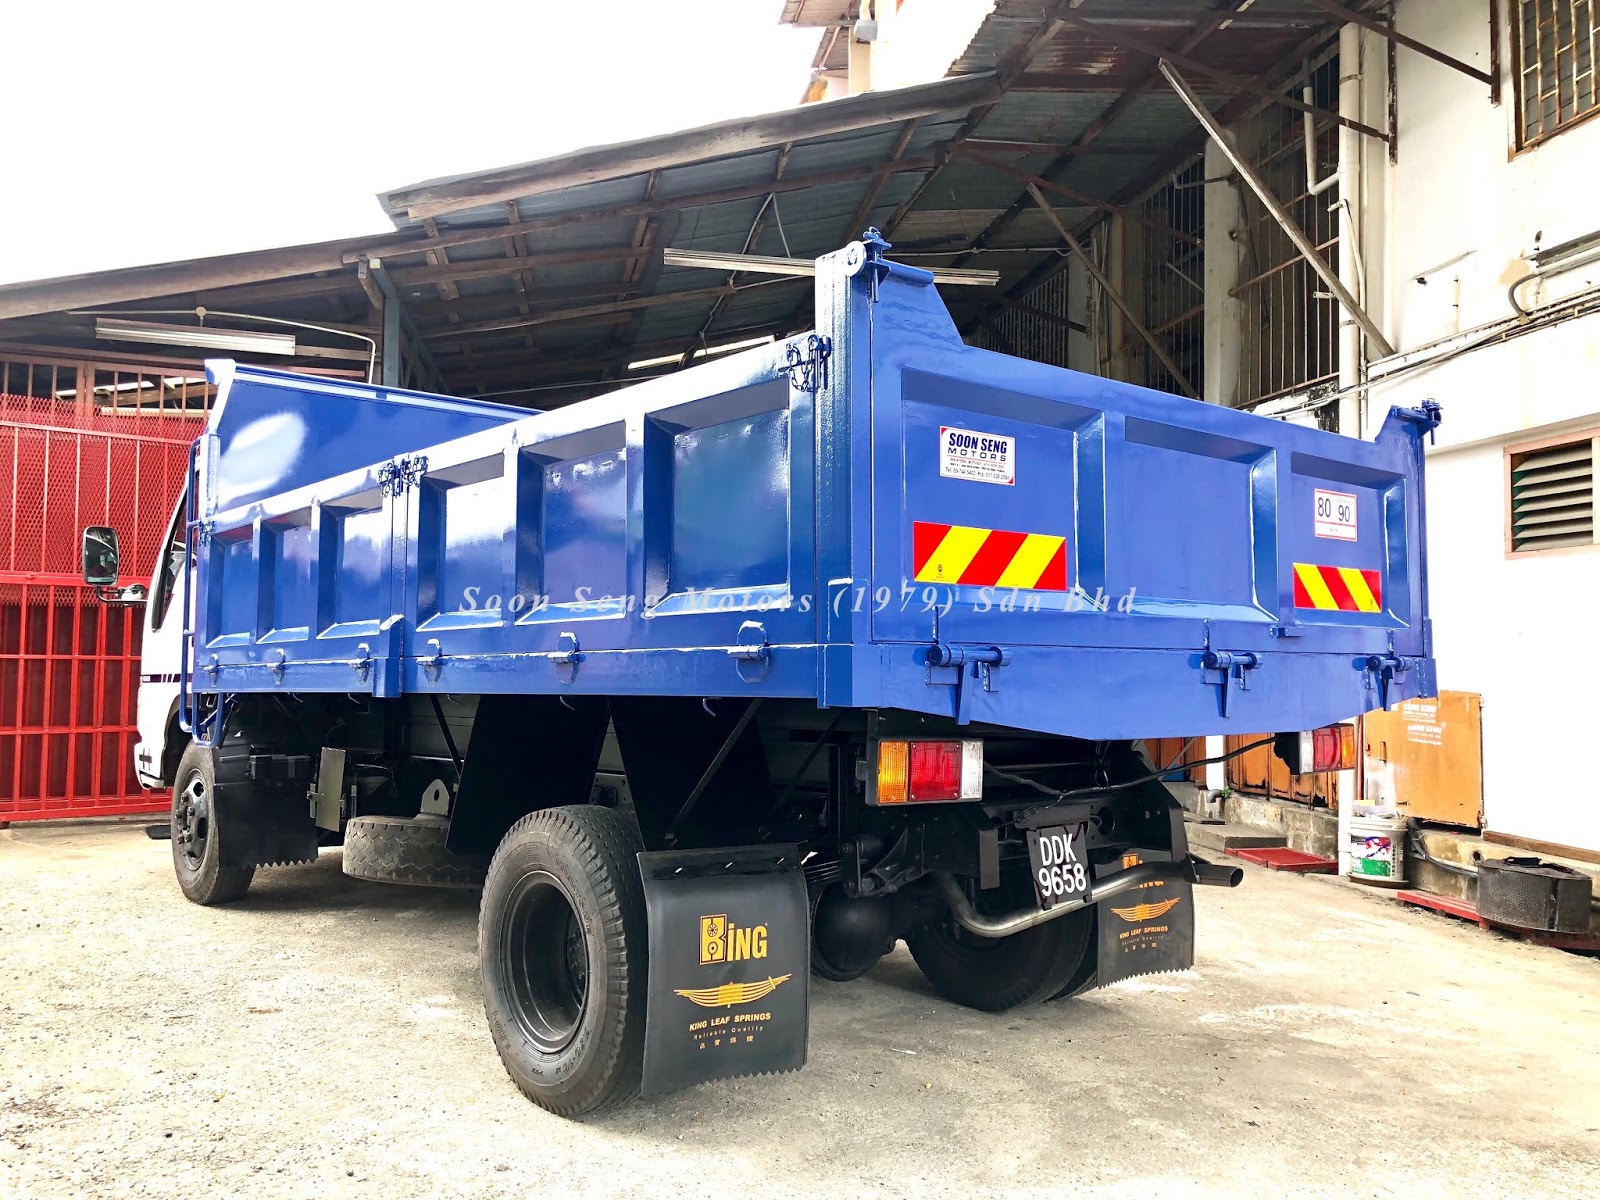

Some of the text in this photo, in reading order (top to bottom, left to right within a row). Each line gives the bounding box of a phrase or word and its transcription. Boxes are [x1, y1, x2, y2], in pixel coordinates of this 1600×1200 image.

[947, 446, 1007, 462] MOTORS
[949, 432, 1008, 455] SOON SENG
[1317, 496, 1351, 523] 80 90
[1039, 833, 1077, 867] DDK
[1038, 863, 1087, 897] 9658
[689, 1012, 772, 1032] KING LEAF SPRINGS
[693, 1026, 764, 1041] Reliable Quality
